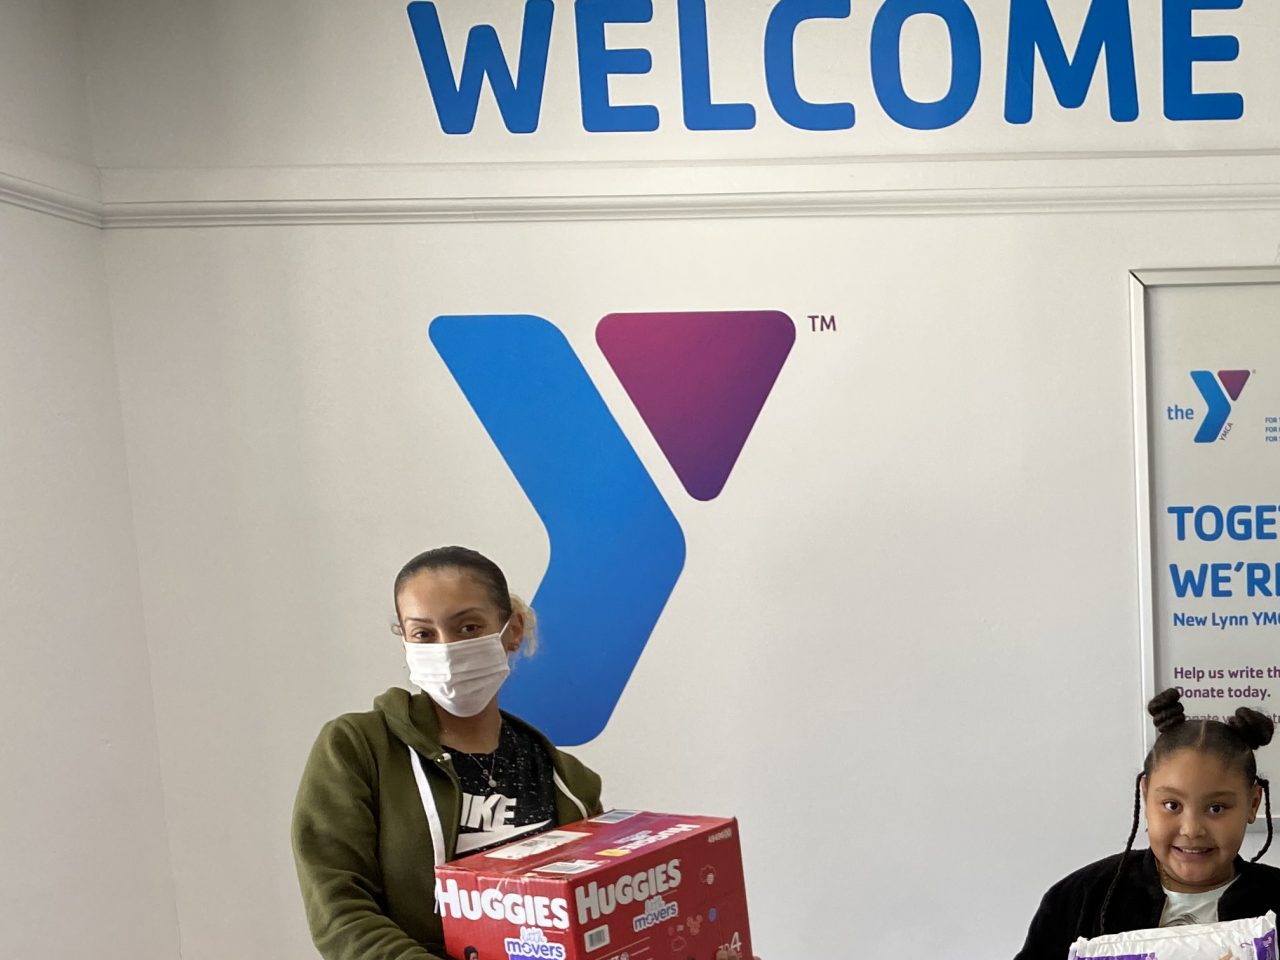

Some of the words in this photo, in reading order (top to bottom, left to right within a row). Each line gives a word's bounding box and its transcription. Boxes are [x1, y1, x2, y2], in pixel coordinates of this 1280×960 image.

[408, 0, 1244, 134] WELCOME
[808, 315, 837, 332] TM
[1167, 404, 1194, 420] the
[1265, 416, 1277, 424] FOR
[1219, 422, 1233, 441] YMCA
[1173, 612, 1206, 626] New
[1211, 612, 1248, 630] Lynn
[1174, 666, 1205, 682] Help
[1208, 669, 1224, 679] us
[1228, 667, 1263, 679] write
[1227, 686, 1271, 700] today.
[460, 792, 517, 832] IKE
[634, 902, 677, 931] movers
[507, 940, 564, 958] movers
